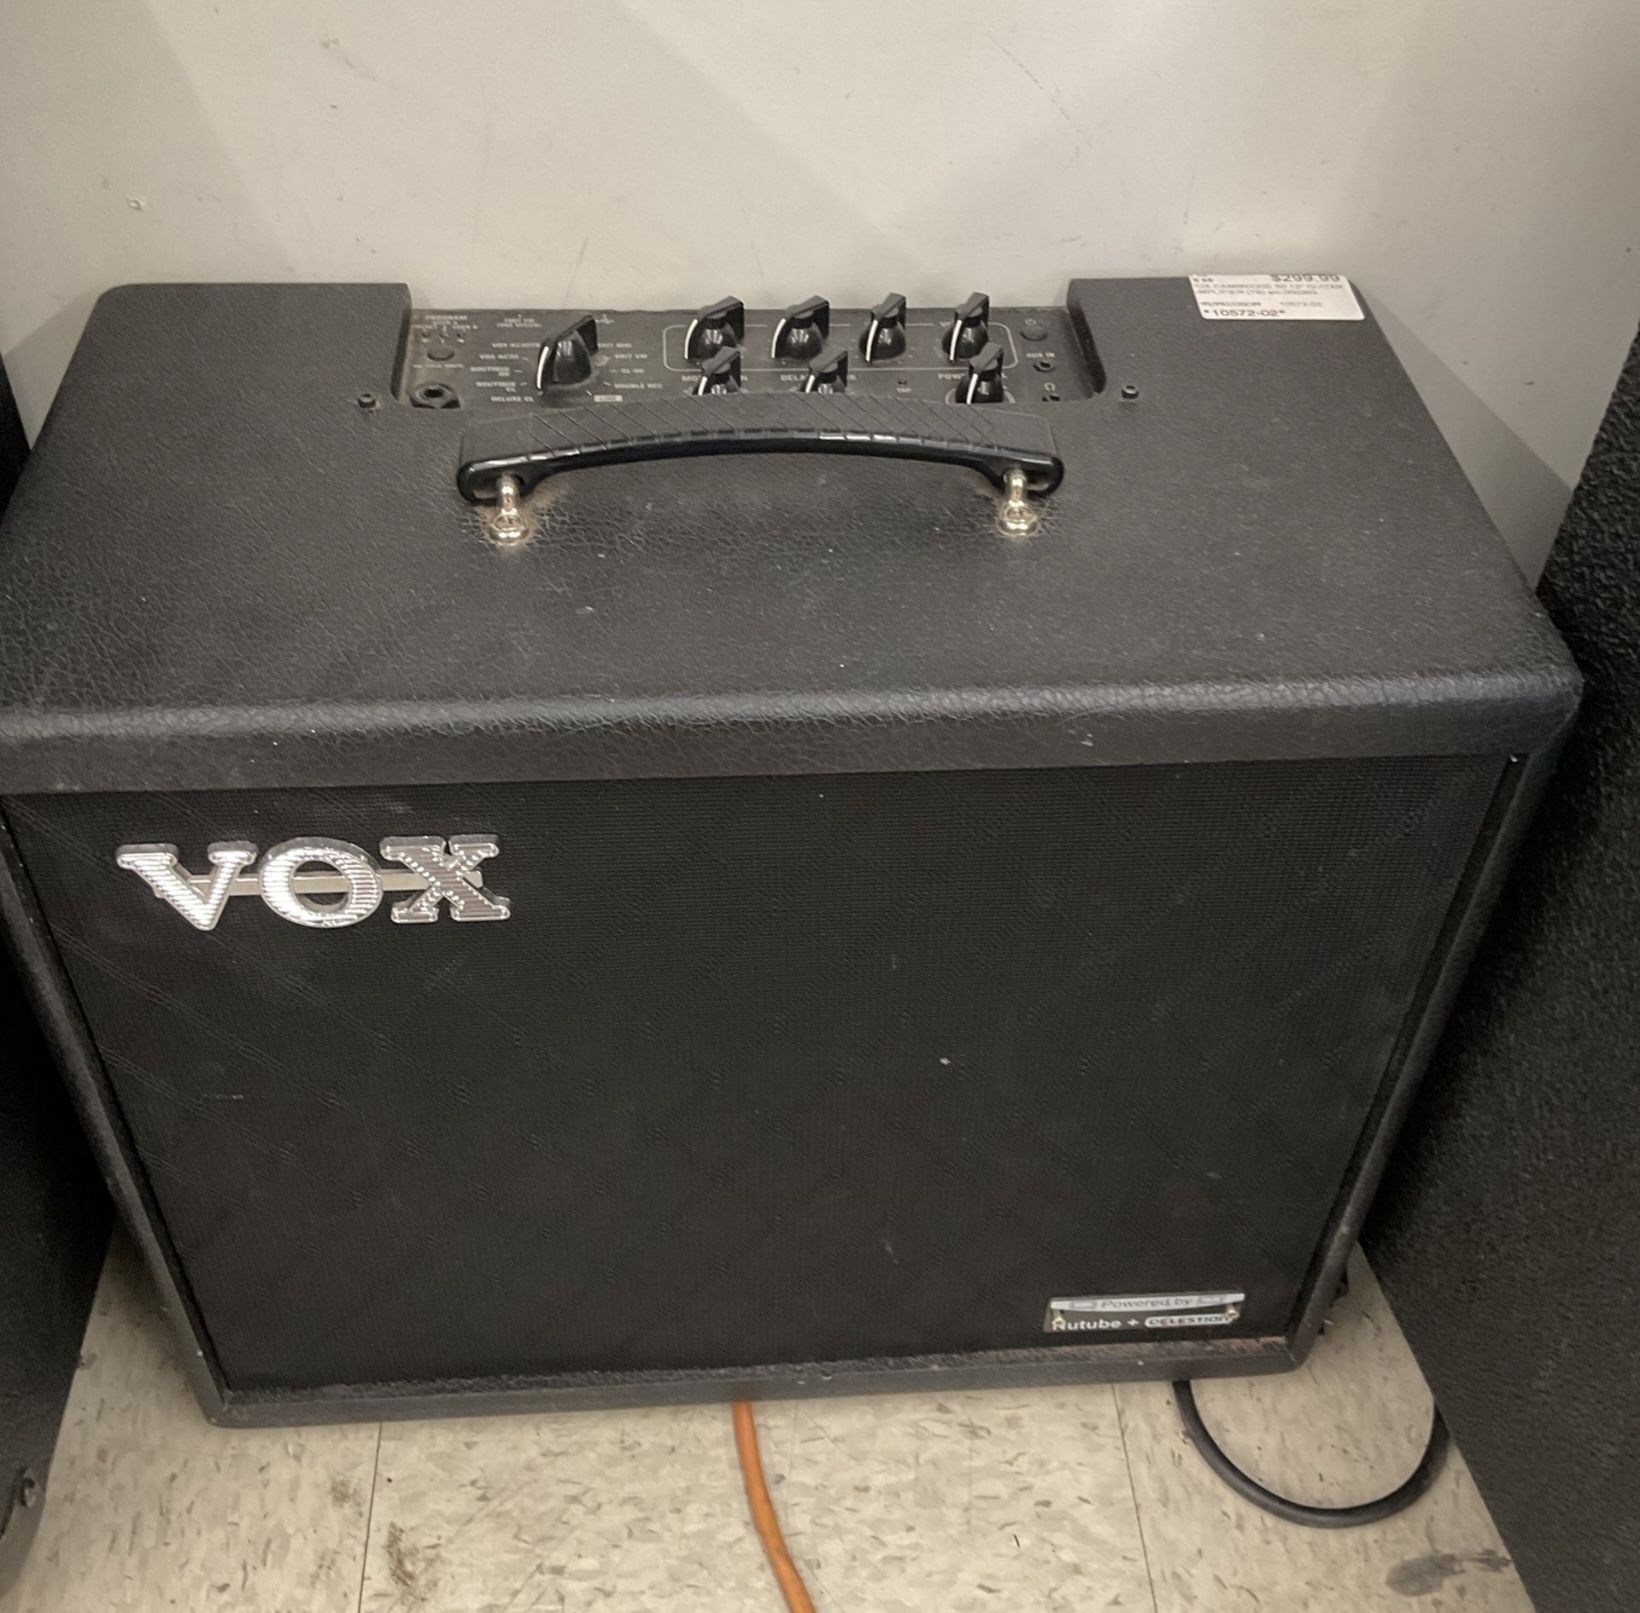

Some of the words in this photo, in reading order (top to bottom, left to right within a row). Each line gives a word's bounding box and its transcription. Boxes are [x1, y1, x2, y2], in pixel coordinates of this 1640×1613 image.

[1269, 273, 1340, 282] $299.99
[116, 833, 512, 931] VOX
[1100, 1297, 1170, 1309] Powered
[1173, 1297, 1194, 1308] by
